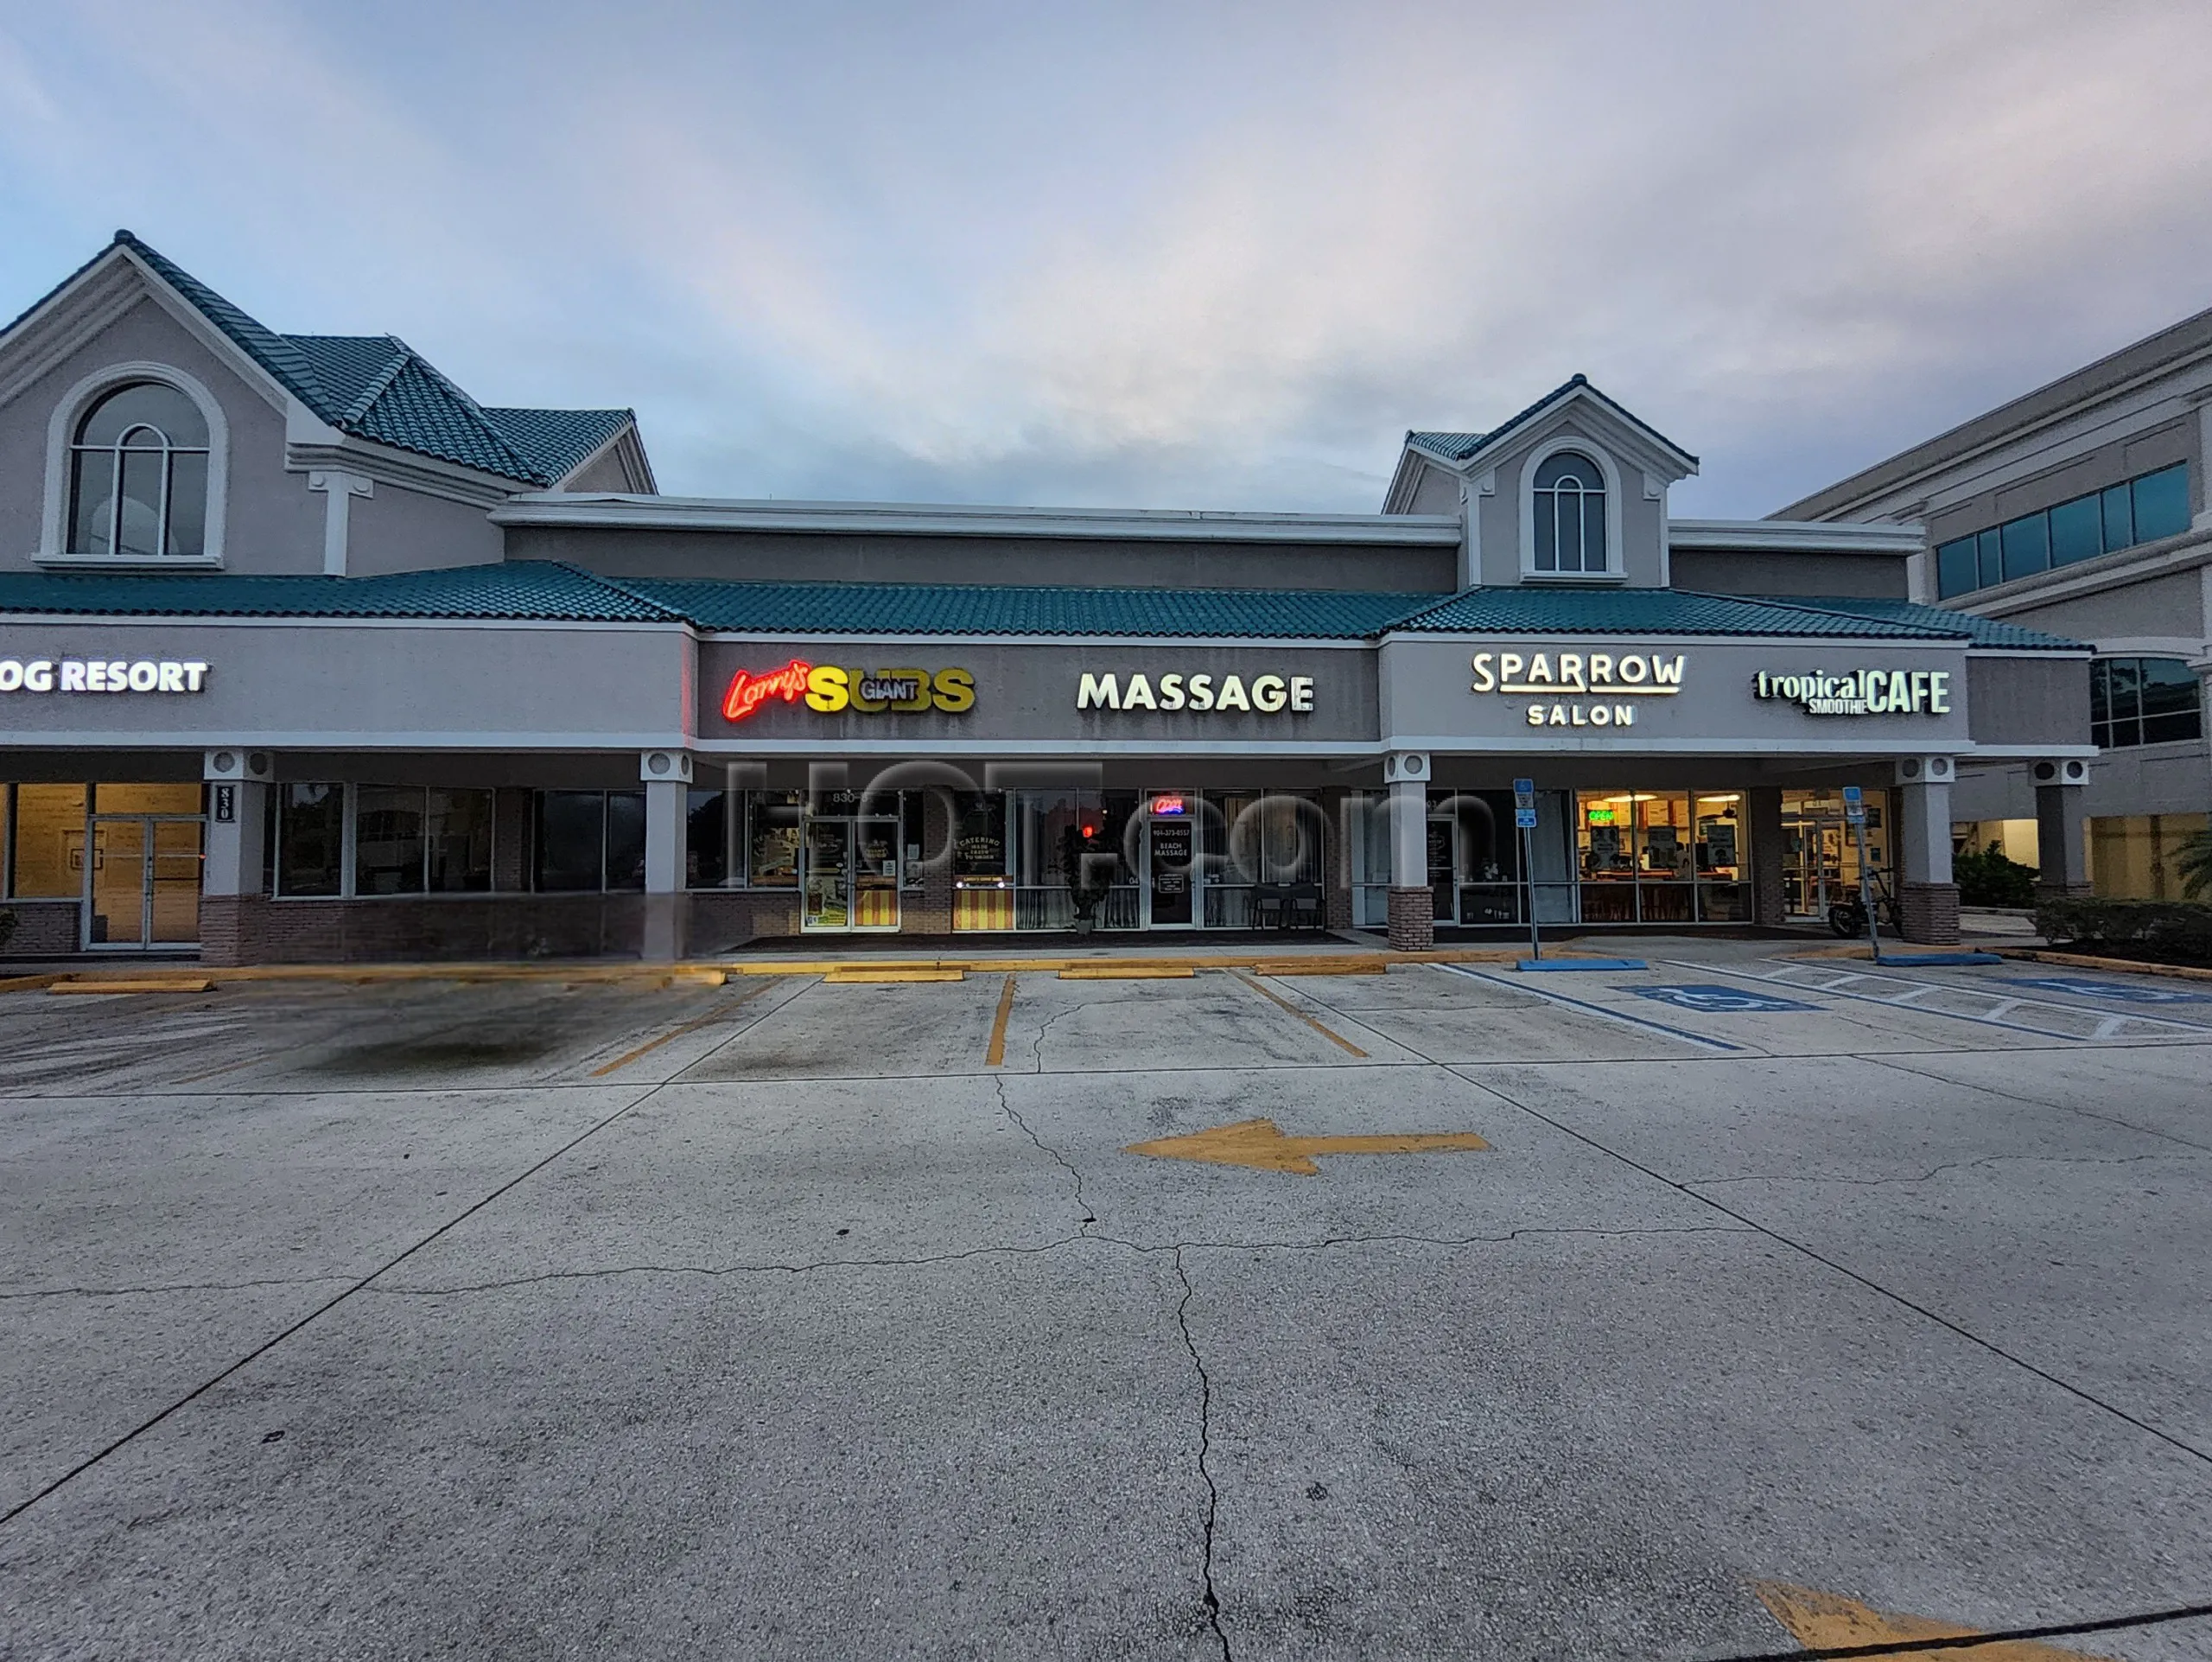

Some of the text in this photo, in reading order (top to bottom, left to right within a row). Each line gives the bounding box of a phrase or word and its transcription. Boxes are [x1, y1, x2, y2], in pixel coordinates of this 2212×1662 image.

[60, 661, 207, 691] RESORT
[1471, 653, 1685, 692] SPARROW
[1758, 669, 1867, 704] tropical
[804, 665, 976, 712] SUBS
[861, 679, 918, 701] GIANT
[1077, 672, 1314, 712] MASSAGE
[1866, 670, 1951, 713] CAFE
[1528, 704, 1633, 725] SALON
[1808, 698, 1867, 715] SMOOTHIE
[219, 787, 231, 819] 830
[1588, 810, 1614, 822] OPEN
[958, 836, 1001, 847] CATERING
